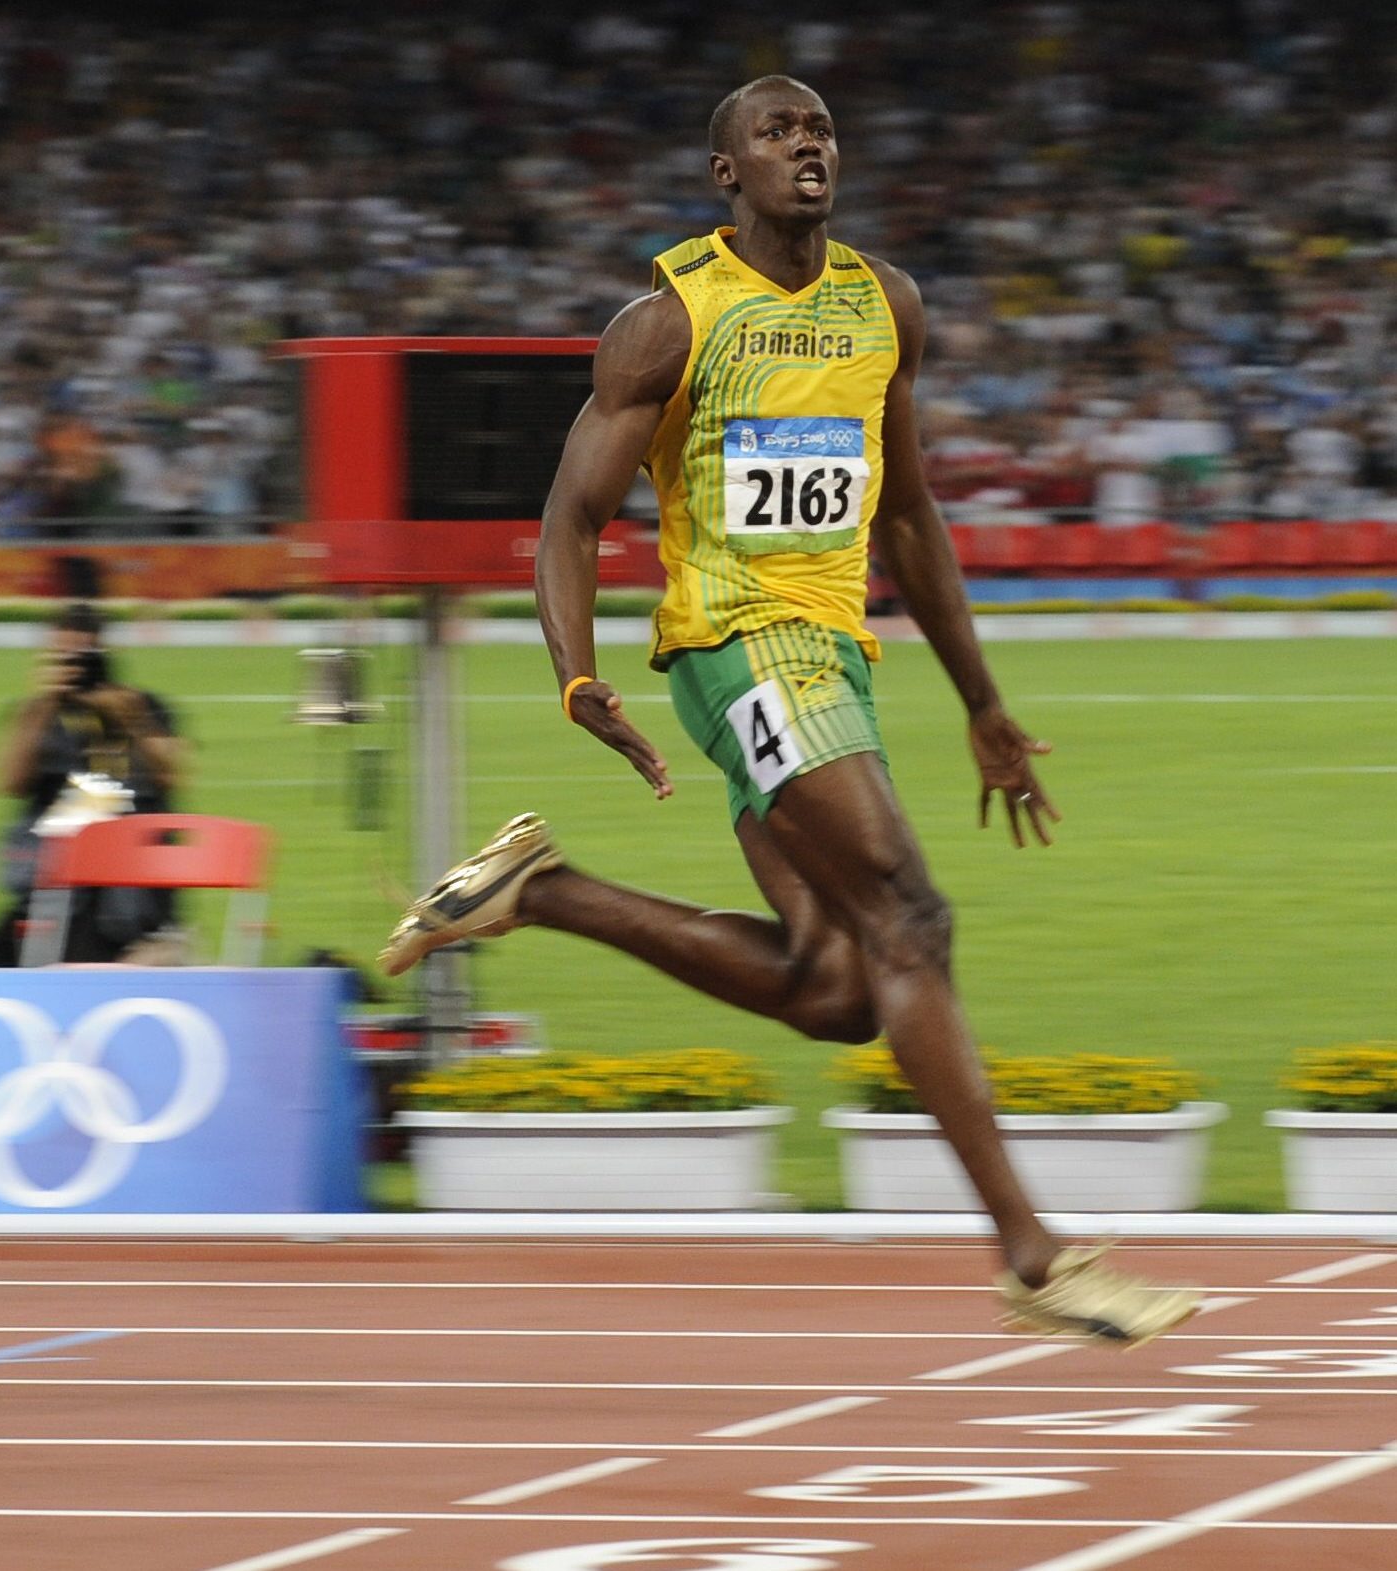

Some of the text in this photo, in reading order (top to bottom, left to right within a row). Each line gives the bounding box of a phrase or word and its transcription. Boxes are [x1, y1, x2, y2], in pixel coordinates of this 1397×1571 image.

[731, 322, 853, 362] jamaica
[745, 467, 853, 525] 2163
[751, 698, 785, 767] 4
[956, 1404, 1261, 1436] 4
[742, 1465, 1122, 1502] 5
